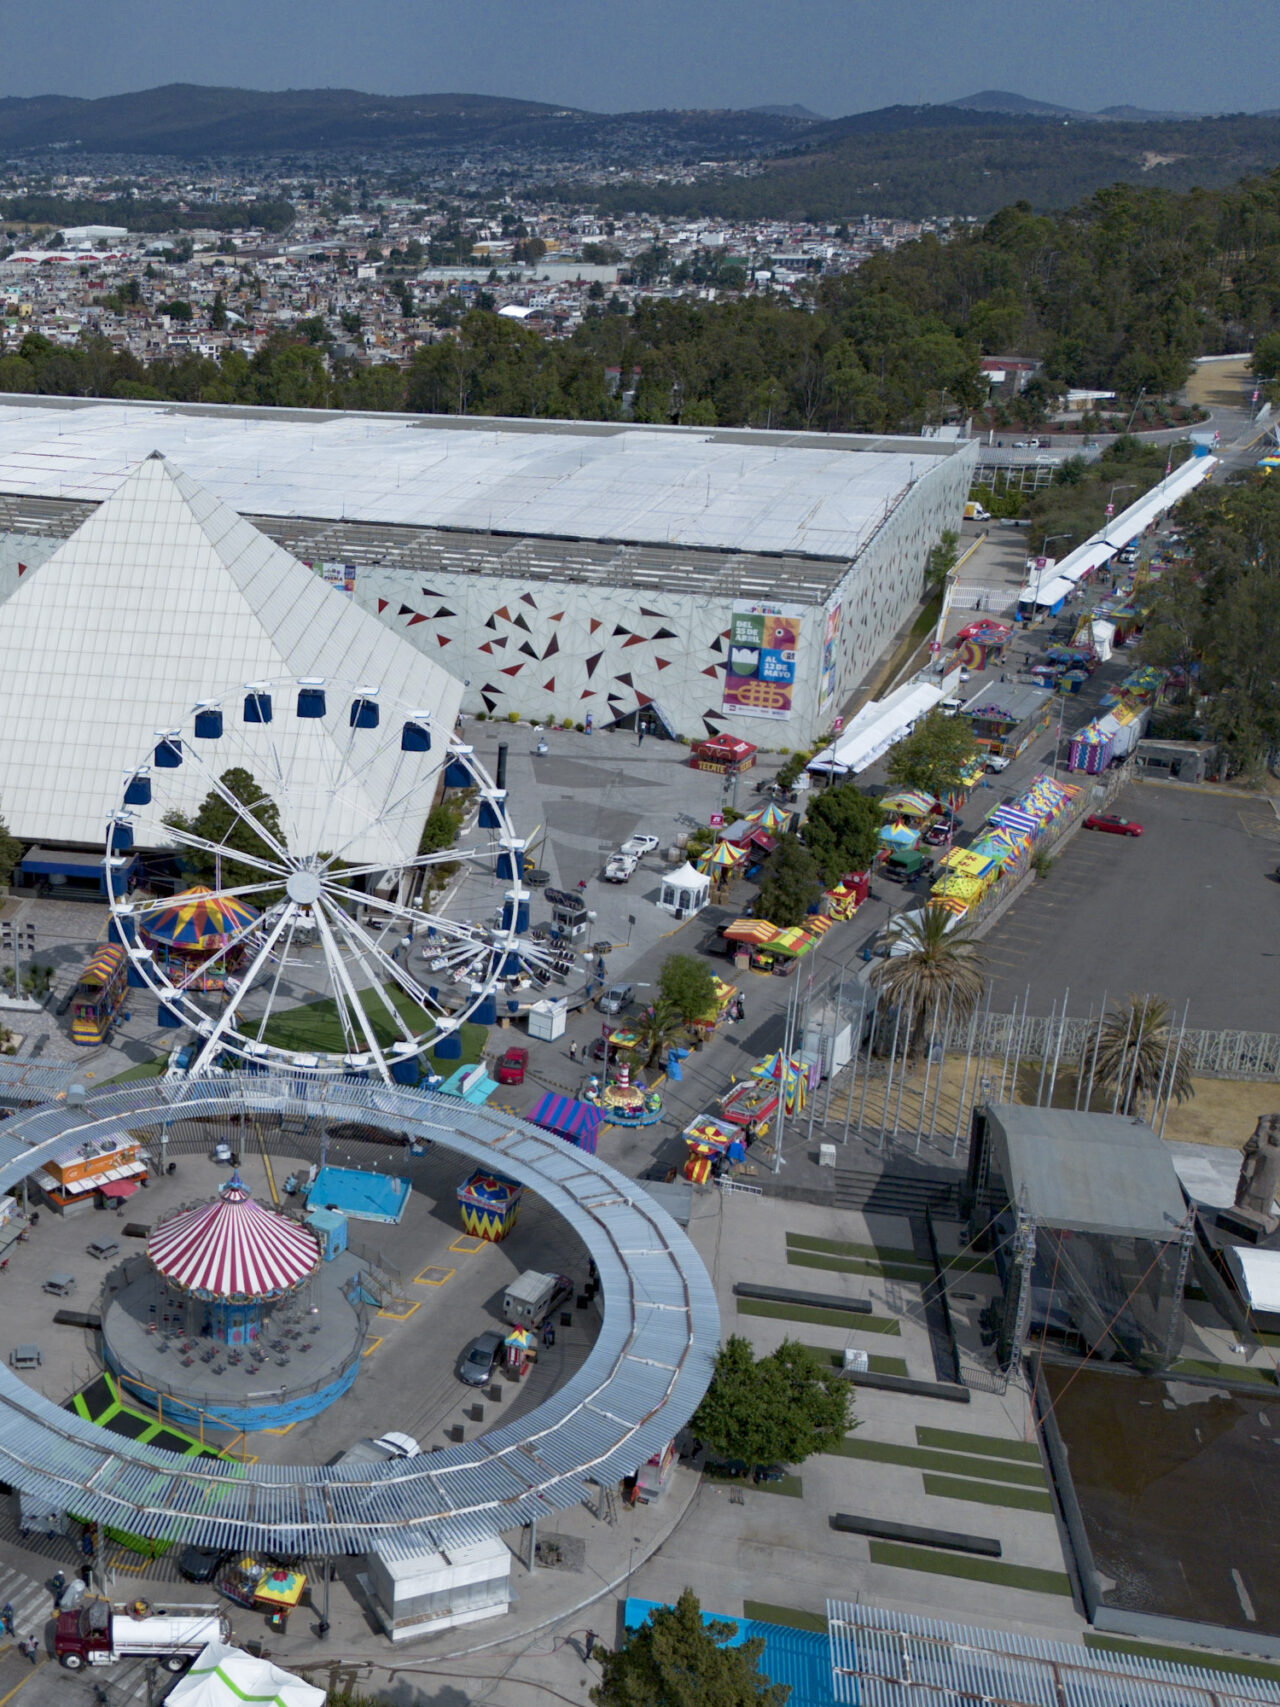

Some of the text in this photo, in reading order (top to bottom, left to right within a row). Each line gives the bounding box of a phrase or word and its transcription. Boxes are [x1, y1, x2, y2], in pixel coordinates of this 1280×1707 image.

[736, 620, 753, 629] DEL
[735, 634, 760, 643] ABRIL
[763, 670, 791, 678] MAYO
[698, 760, 725, 774] TECATE
